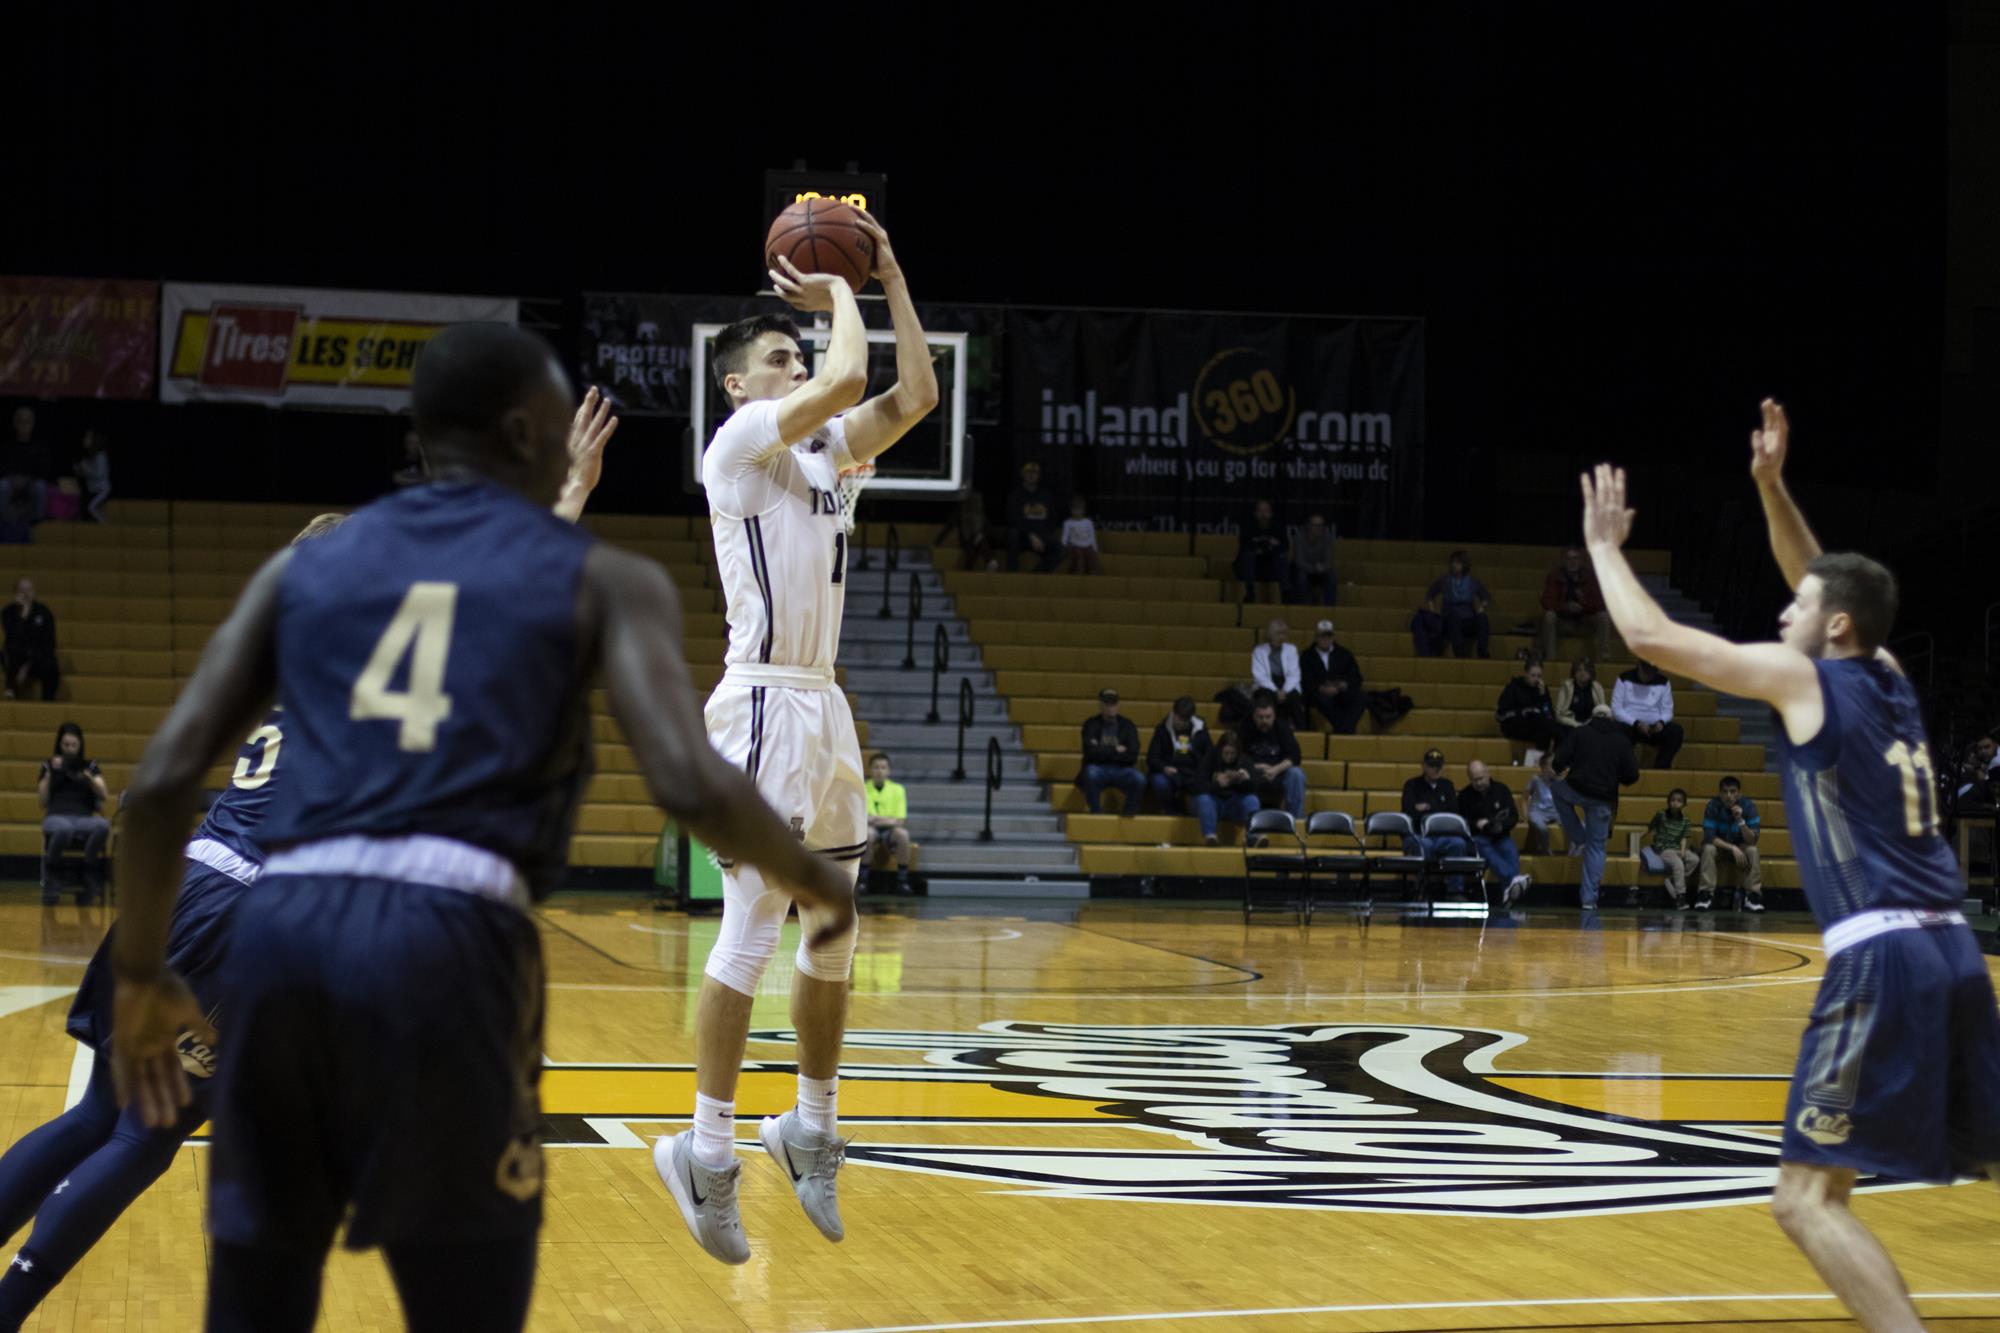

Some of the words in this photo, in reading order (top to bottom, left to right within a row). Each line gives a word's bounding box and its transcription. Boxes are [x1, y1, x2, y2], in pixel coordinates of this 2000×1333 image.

[212, 317, 288, 367] Tires
[295, 336, 348, 367] LES
[1041, 388, 1189, 447] inland
[1205, 369, 1282, 435] 360
[1224, 459, 1247, 483] go
[1250, 456, 1278, 477] for
[1330, 460, 1364, 485] you
[350, 581, 458, 752] 4
[1885, 740, 1939, 836] 11
[1797, 1106, 1854, 1142] Cats
